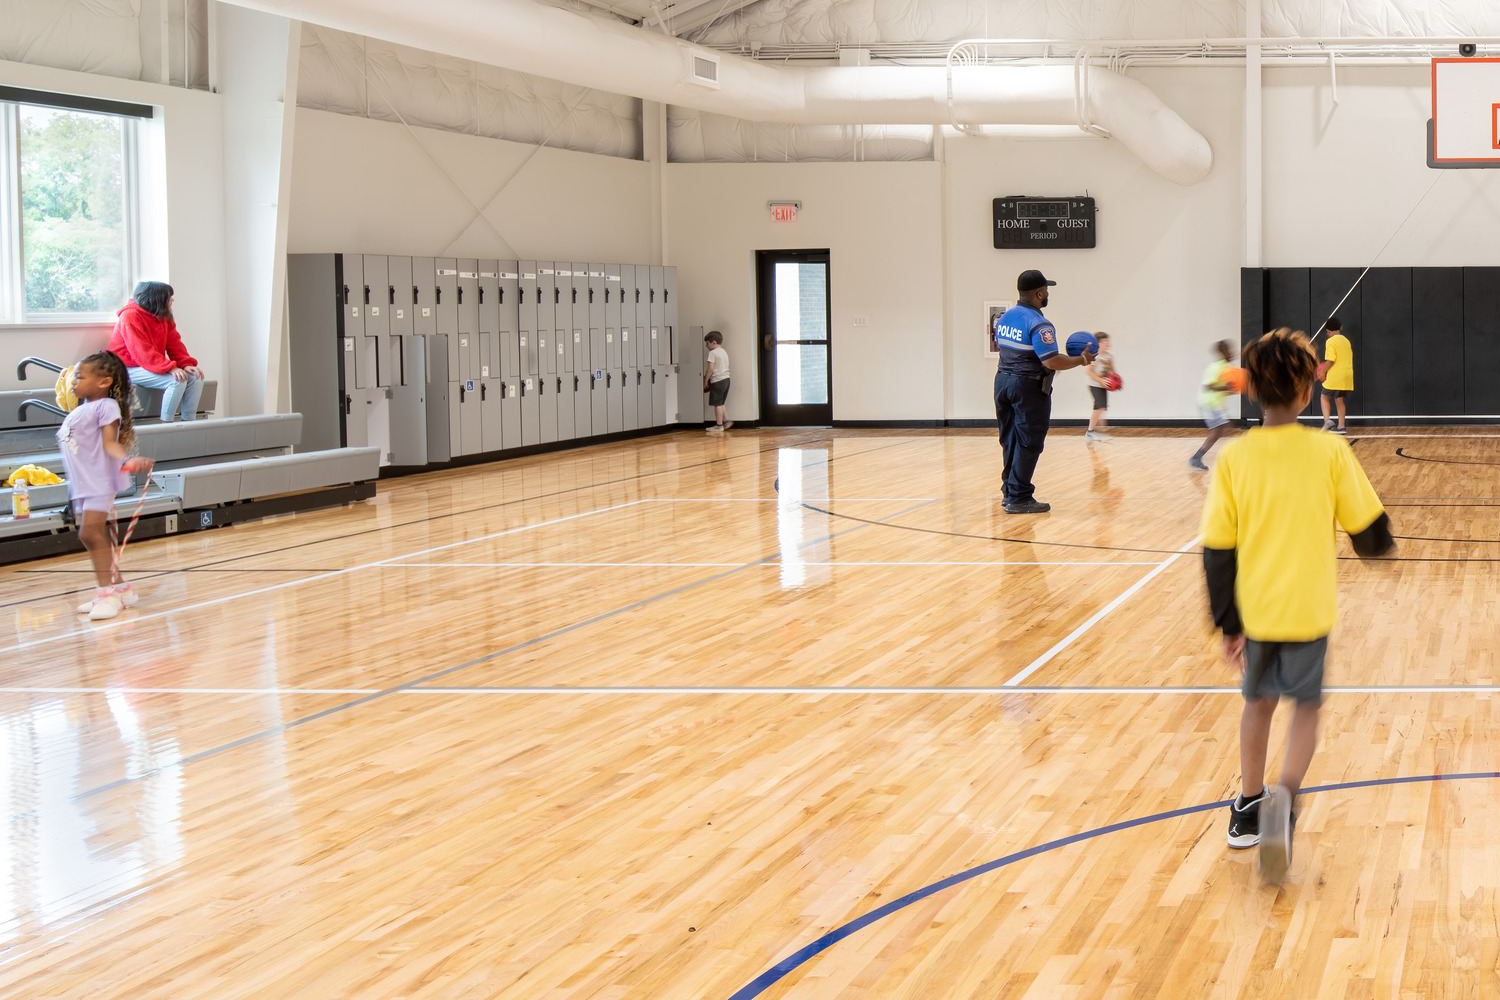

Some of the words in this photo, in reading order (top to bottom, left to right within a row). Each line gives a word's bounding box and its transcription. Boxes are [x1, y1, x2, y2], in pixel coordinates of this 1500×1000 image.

[775, 206, 793, 220] EXIT
[997, 219, 1030, 229] HOME
[1057, 219, 1090, 228] GUEST
[1030, 232, 1058, 240] PERIOD
[997, 325, 1023, 341] POLICE
